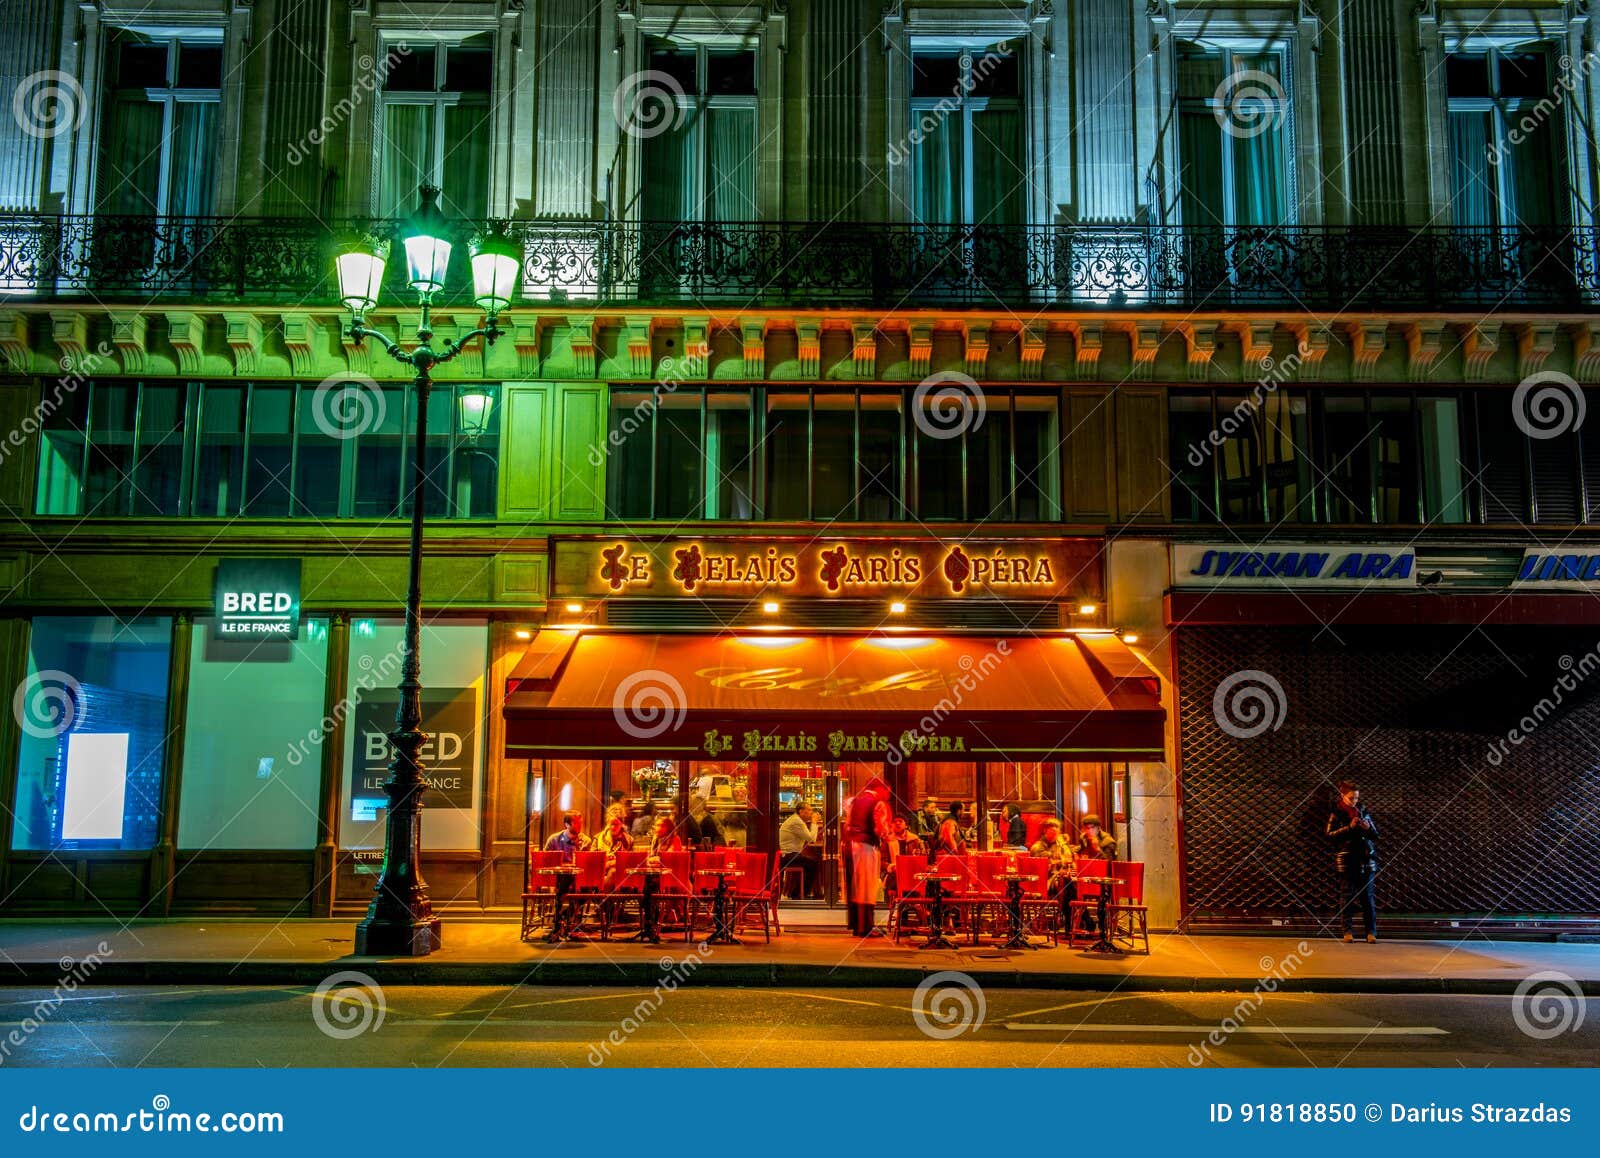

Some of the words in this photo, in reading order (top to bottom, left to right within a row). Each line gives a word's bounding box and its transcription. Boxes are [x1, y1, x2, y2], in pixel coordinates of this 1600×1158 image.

[1190, 550, 1330, 577] SYRIAN
[1331, 553, 1415, 579] ARA
[223, 592, 292, 612] BRED
[222, 623, 236, 632] ILE
[237, 623, 251, 632] DE
[252, 623, 291, 632] FRANCE
[365, 732, 463, 760] BED
[363, 777, 383, 789] ILE
